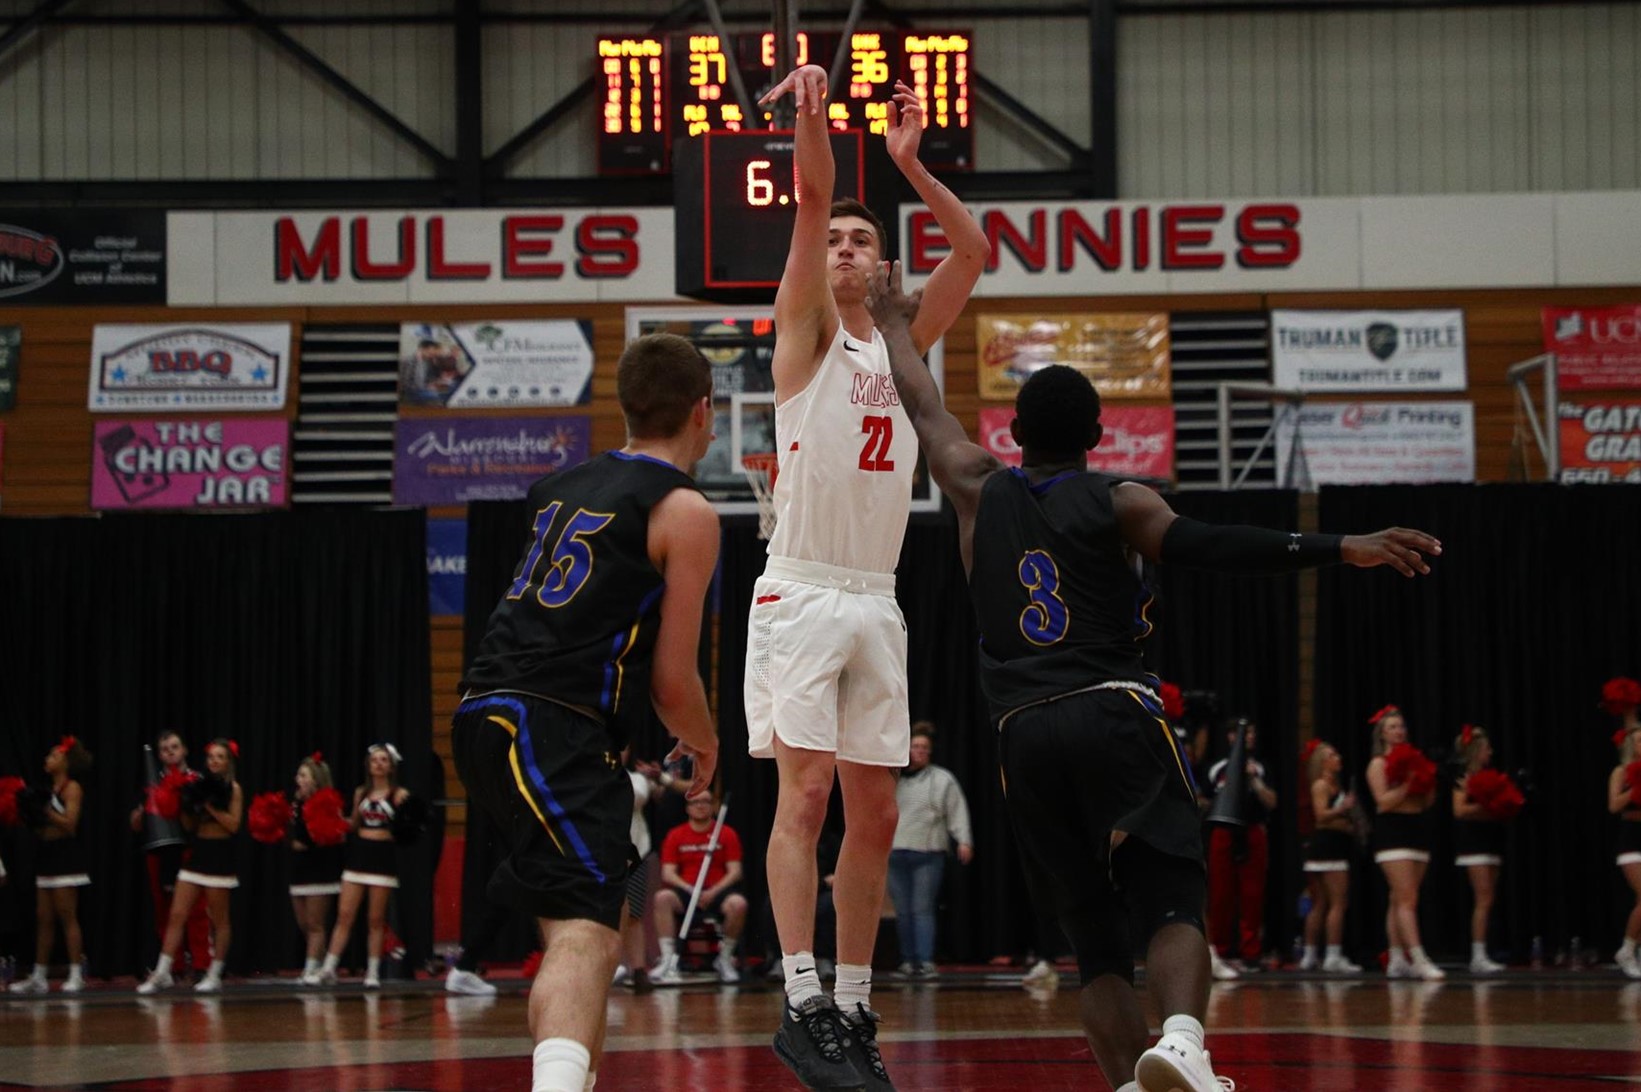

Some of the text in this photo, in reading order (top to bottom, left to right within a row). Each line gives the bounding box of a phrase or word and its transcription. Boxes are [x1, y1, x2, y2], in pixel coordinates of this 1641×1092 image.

[689, 52, 726, 86] 37
[851, 50, 888, 83] 36
[274, 214, 640, 284] MULES
[1279, 324, 1458, 349] TRUMAN TITLE
[1590, 315, 1641, 343] UC
[149, 350, 233, 379] BBQ
[155, 421, 223, 444] THE
[1397, 408, 1463, 426] Printing
[114, 444, 283, 474] CHANGE
[858, 415, 895, 472] 22
[196, 474, 271, 505] JAR
[506, 501, 615, 608] 15
[1018, 549, 1070, 647] 3
